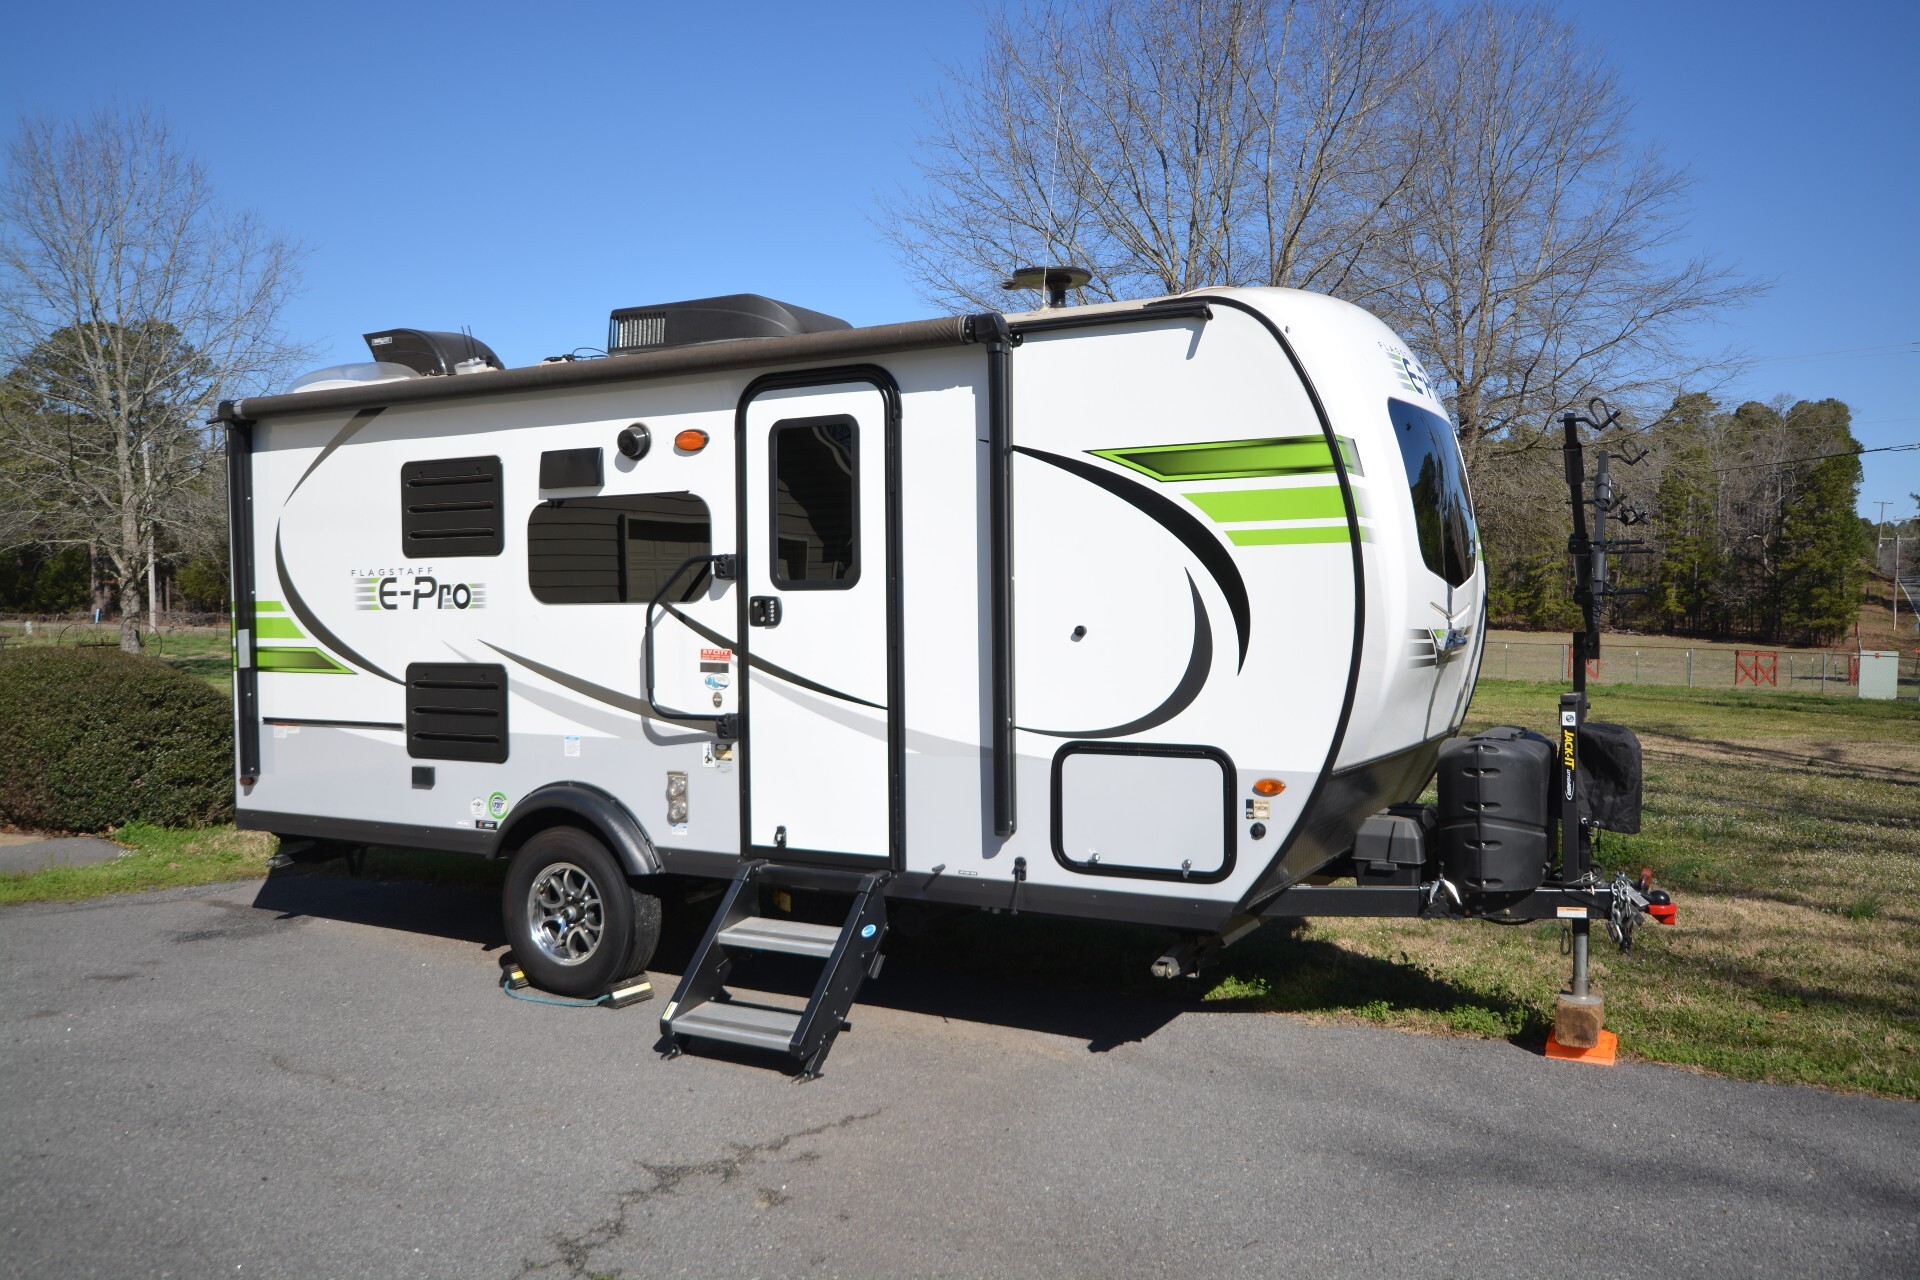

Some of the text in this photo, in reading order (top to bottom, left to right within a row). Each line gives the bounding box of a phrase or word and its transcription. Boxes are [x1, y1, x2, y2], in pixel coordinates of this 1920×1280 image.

[350, 567, 434, 577] FLAGSTAFF
[379, 576, 472, 610] E-Pro
[1564, 729, 1575, 770] JACK-IT
